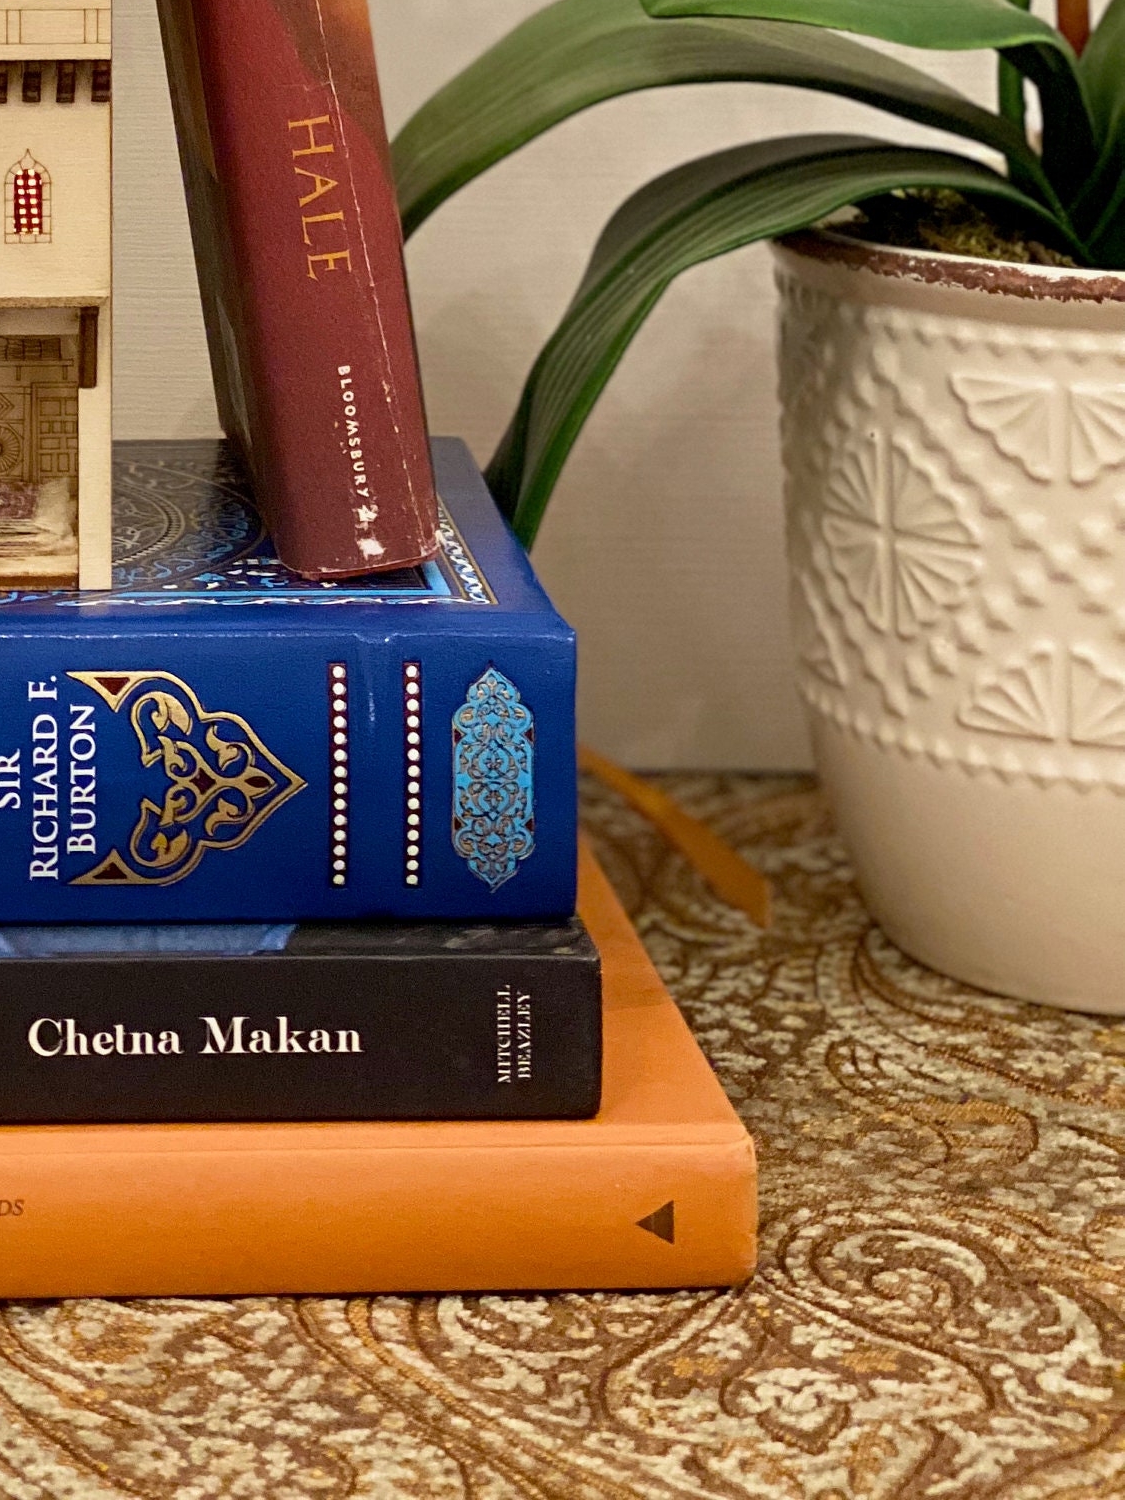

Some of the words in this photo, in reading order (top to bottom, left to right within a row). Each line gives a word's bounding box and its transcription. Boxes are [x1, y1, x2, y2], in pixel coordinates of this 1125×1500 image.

[287, 114, 352, 282] HALE
[338, 365, 369, 498] BLOOMSBURY
[28, 675, 58, 701] F.
[29, 714, 59, 881] RICHARD
[67, 704, 97, 854] BURTON
[27, 1016, 184, 1057] Chetna
[199, 1016, 364, 1055] Makan
[497, 984, 511, 1083] MITCHELL
[517, 990, 531, 1078] BEAZLEY
